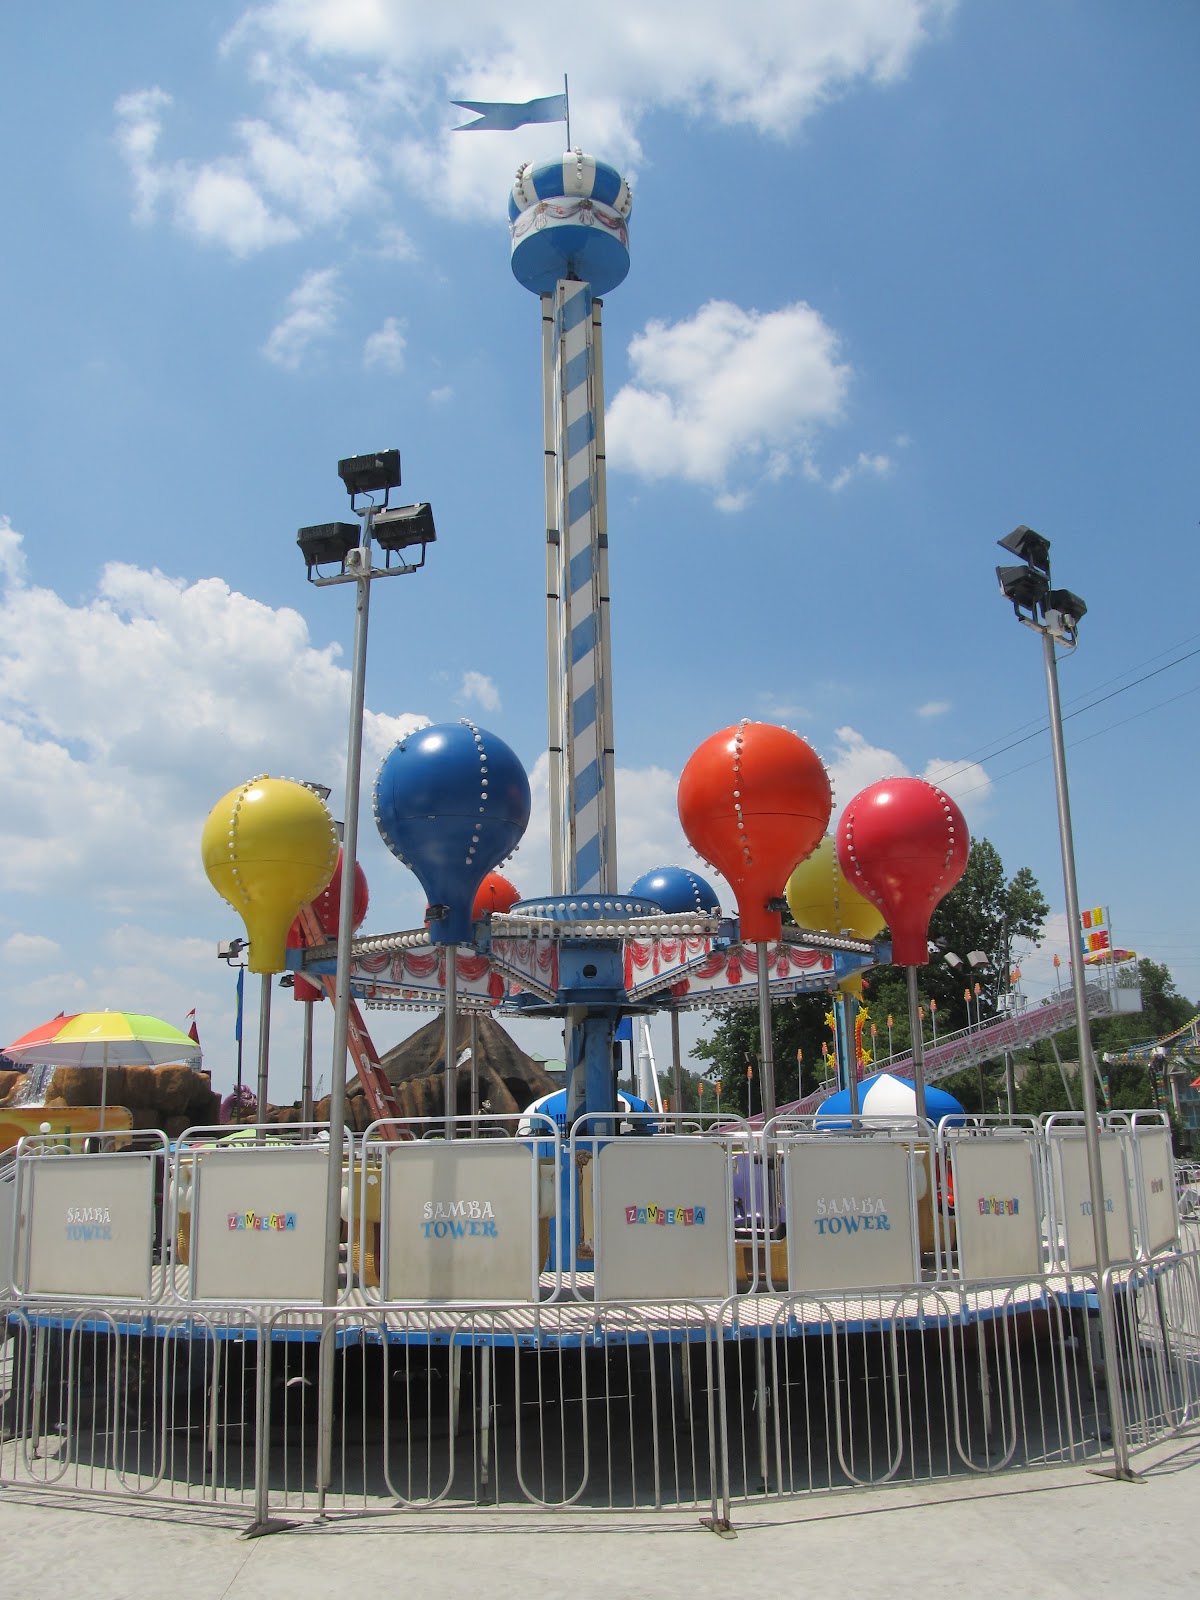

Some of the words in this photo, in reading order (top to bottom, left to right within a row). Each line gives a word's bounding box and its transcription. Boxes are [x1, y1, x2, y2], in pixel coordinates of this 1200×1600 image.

[1079, 907, 1104, 929] UN
[1080, 930, 1110, 954] LIDE
[67, 1207, 111, 1223] SAMBA
[422, 1200, 496, 1219] SAMBA
[625, 1204, 705, 1225] ZAMPERLA
[816, 1196, 888, 1215] SAMBA
[228, 1211, 296, 1231] ZAMPERLA
[420, 1219, 498, 1239] TOWER
[814, 1214, 891, 1235] TOWER
[65, 1224, 112, 1242] TOWER
